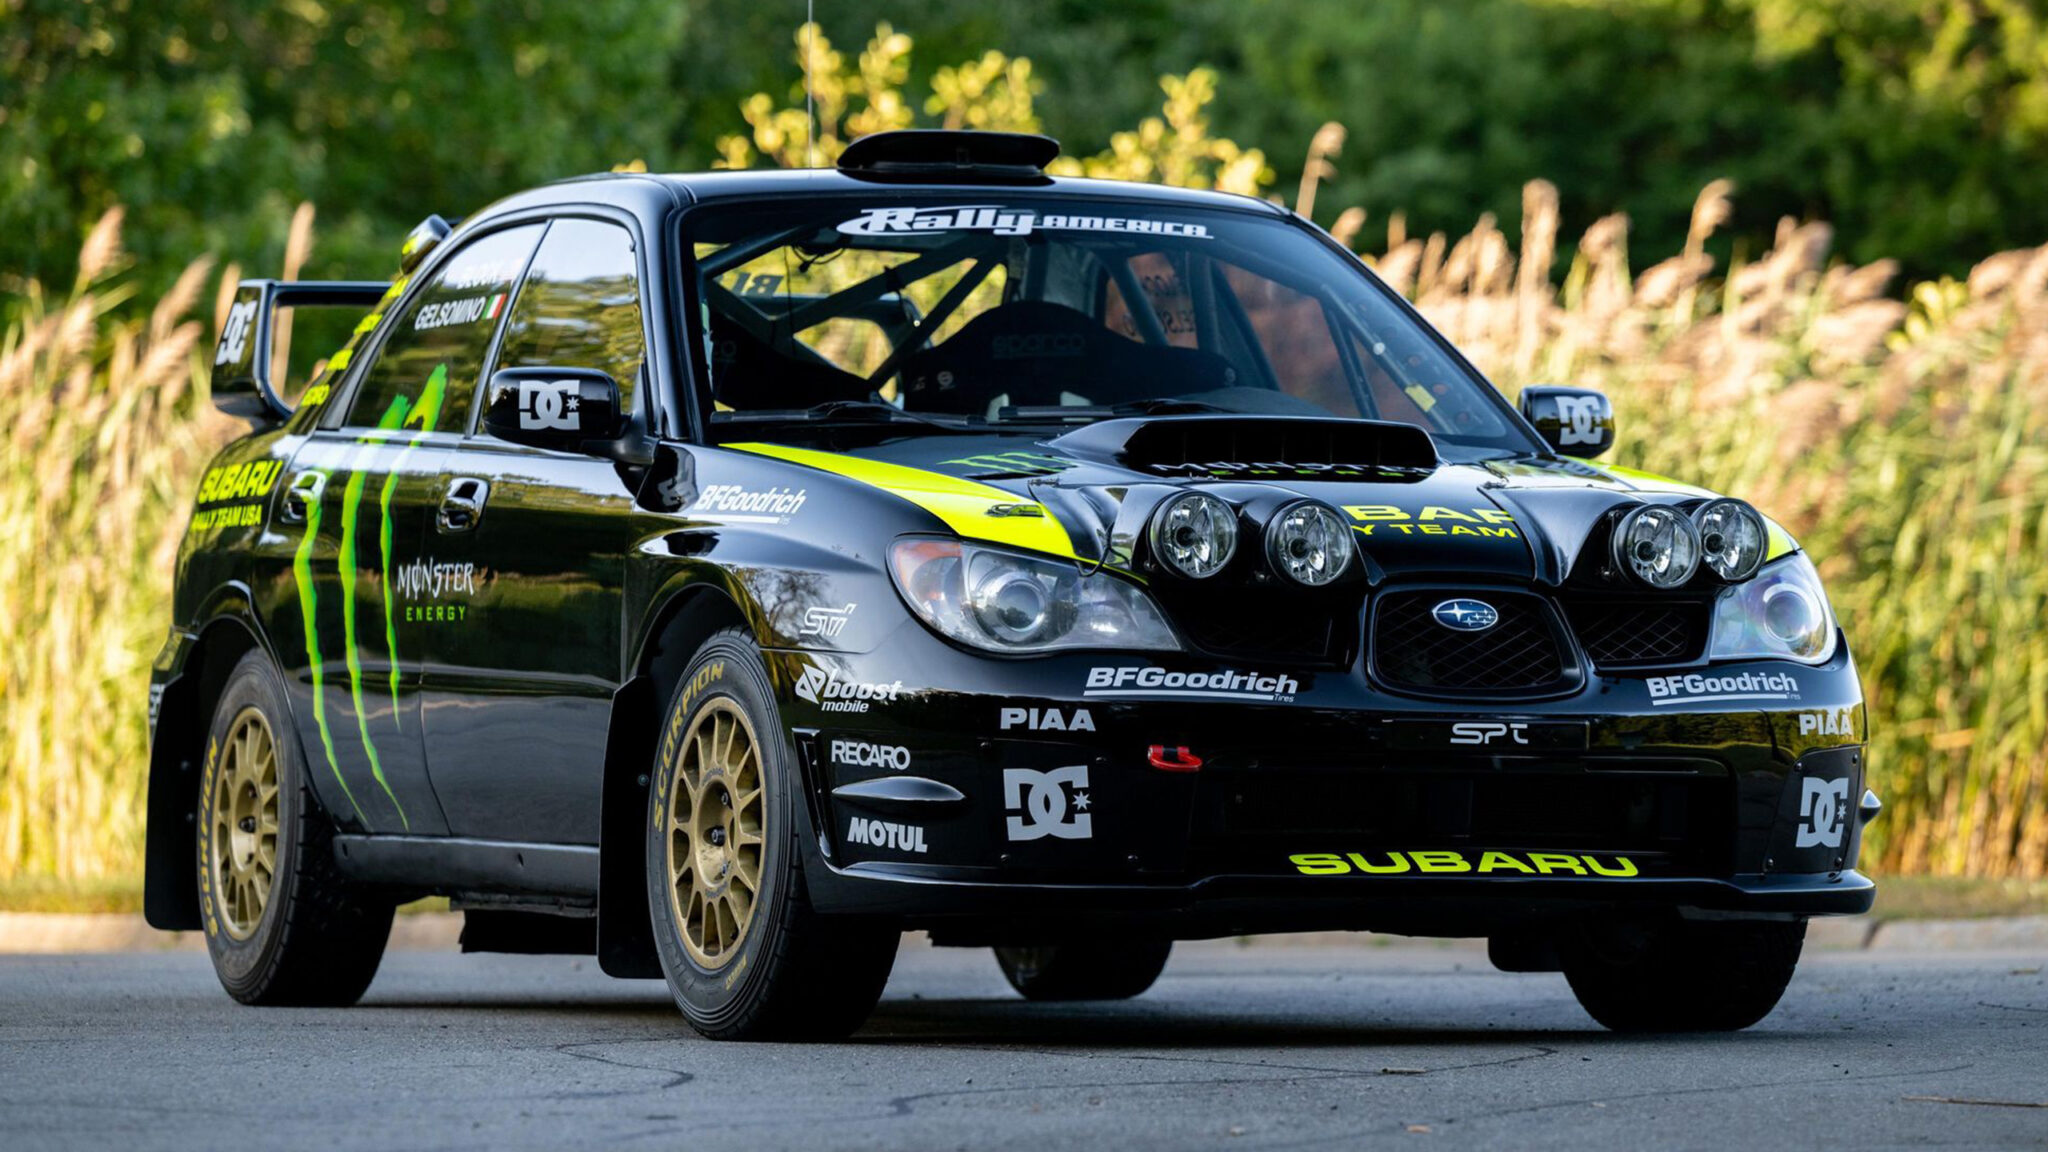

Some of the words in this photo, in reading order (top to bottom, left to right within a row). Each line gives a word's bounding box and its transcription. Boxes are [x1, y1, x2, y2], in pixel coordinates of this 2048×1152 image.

[837, 205, 1036, 235] Rally
[414, 296, 486, 331] GELSOMINO
[216, 300, 257, 365] DC
[520, 380, 580, 430] DC
[1555, 396, 1603, 445] DC
[199, 460, 283, 504] SUBARU
[694, 485, 807, 513] BFGoodrich
[241, 504, 263, 527] USA
[1389, 524, 1518, 538] TEAM
[397, 555, 474, 600] MONSTER
[406, 606, 465, 621] ENERGY
[822, 668, 902, 701] boost
[1085, 667, 1298, 694] BFGoodrich
[1646, 672, 1798, 697] BFGoodrich
[821, 700, 869, 713] mobile
[1000, 708, 1096, 731] PIAA
[1799, 708, 1853, 735] PIAA
[654, 661, 724, 832] SCORPION
[1450, 723, 1528, 744] SPT
[831, 740, 910, 770] RECARO
[1003, 765, 1092, 841] DC
[1796, 777, 1849, 847] DC
[847, 817, 928, 853] MOTUL
[1289, 851, 1639, 877] SUBARU
